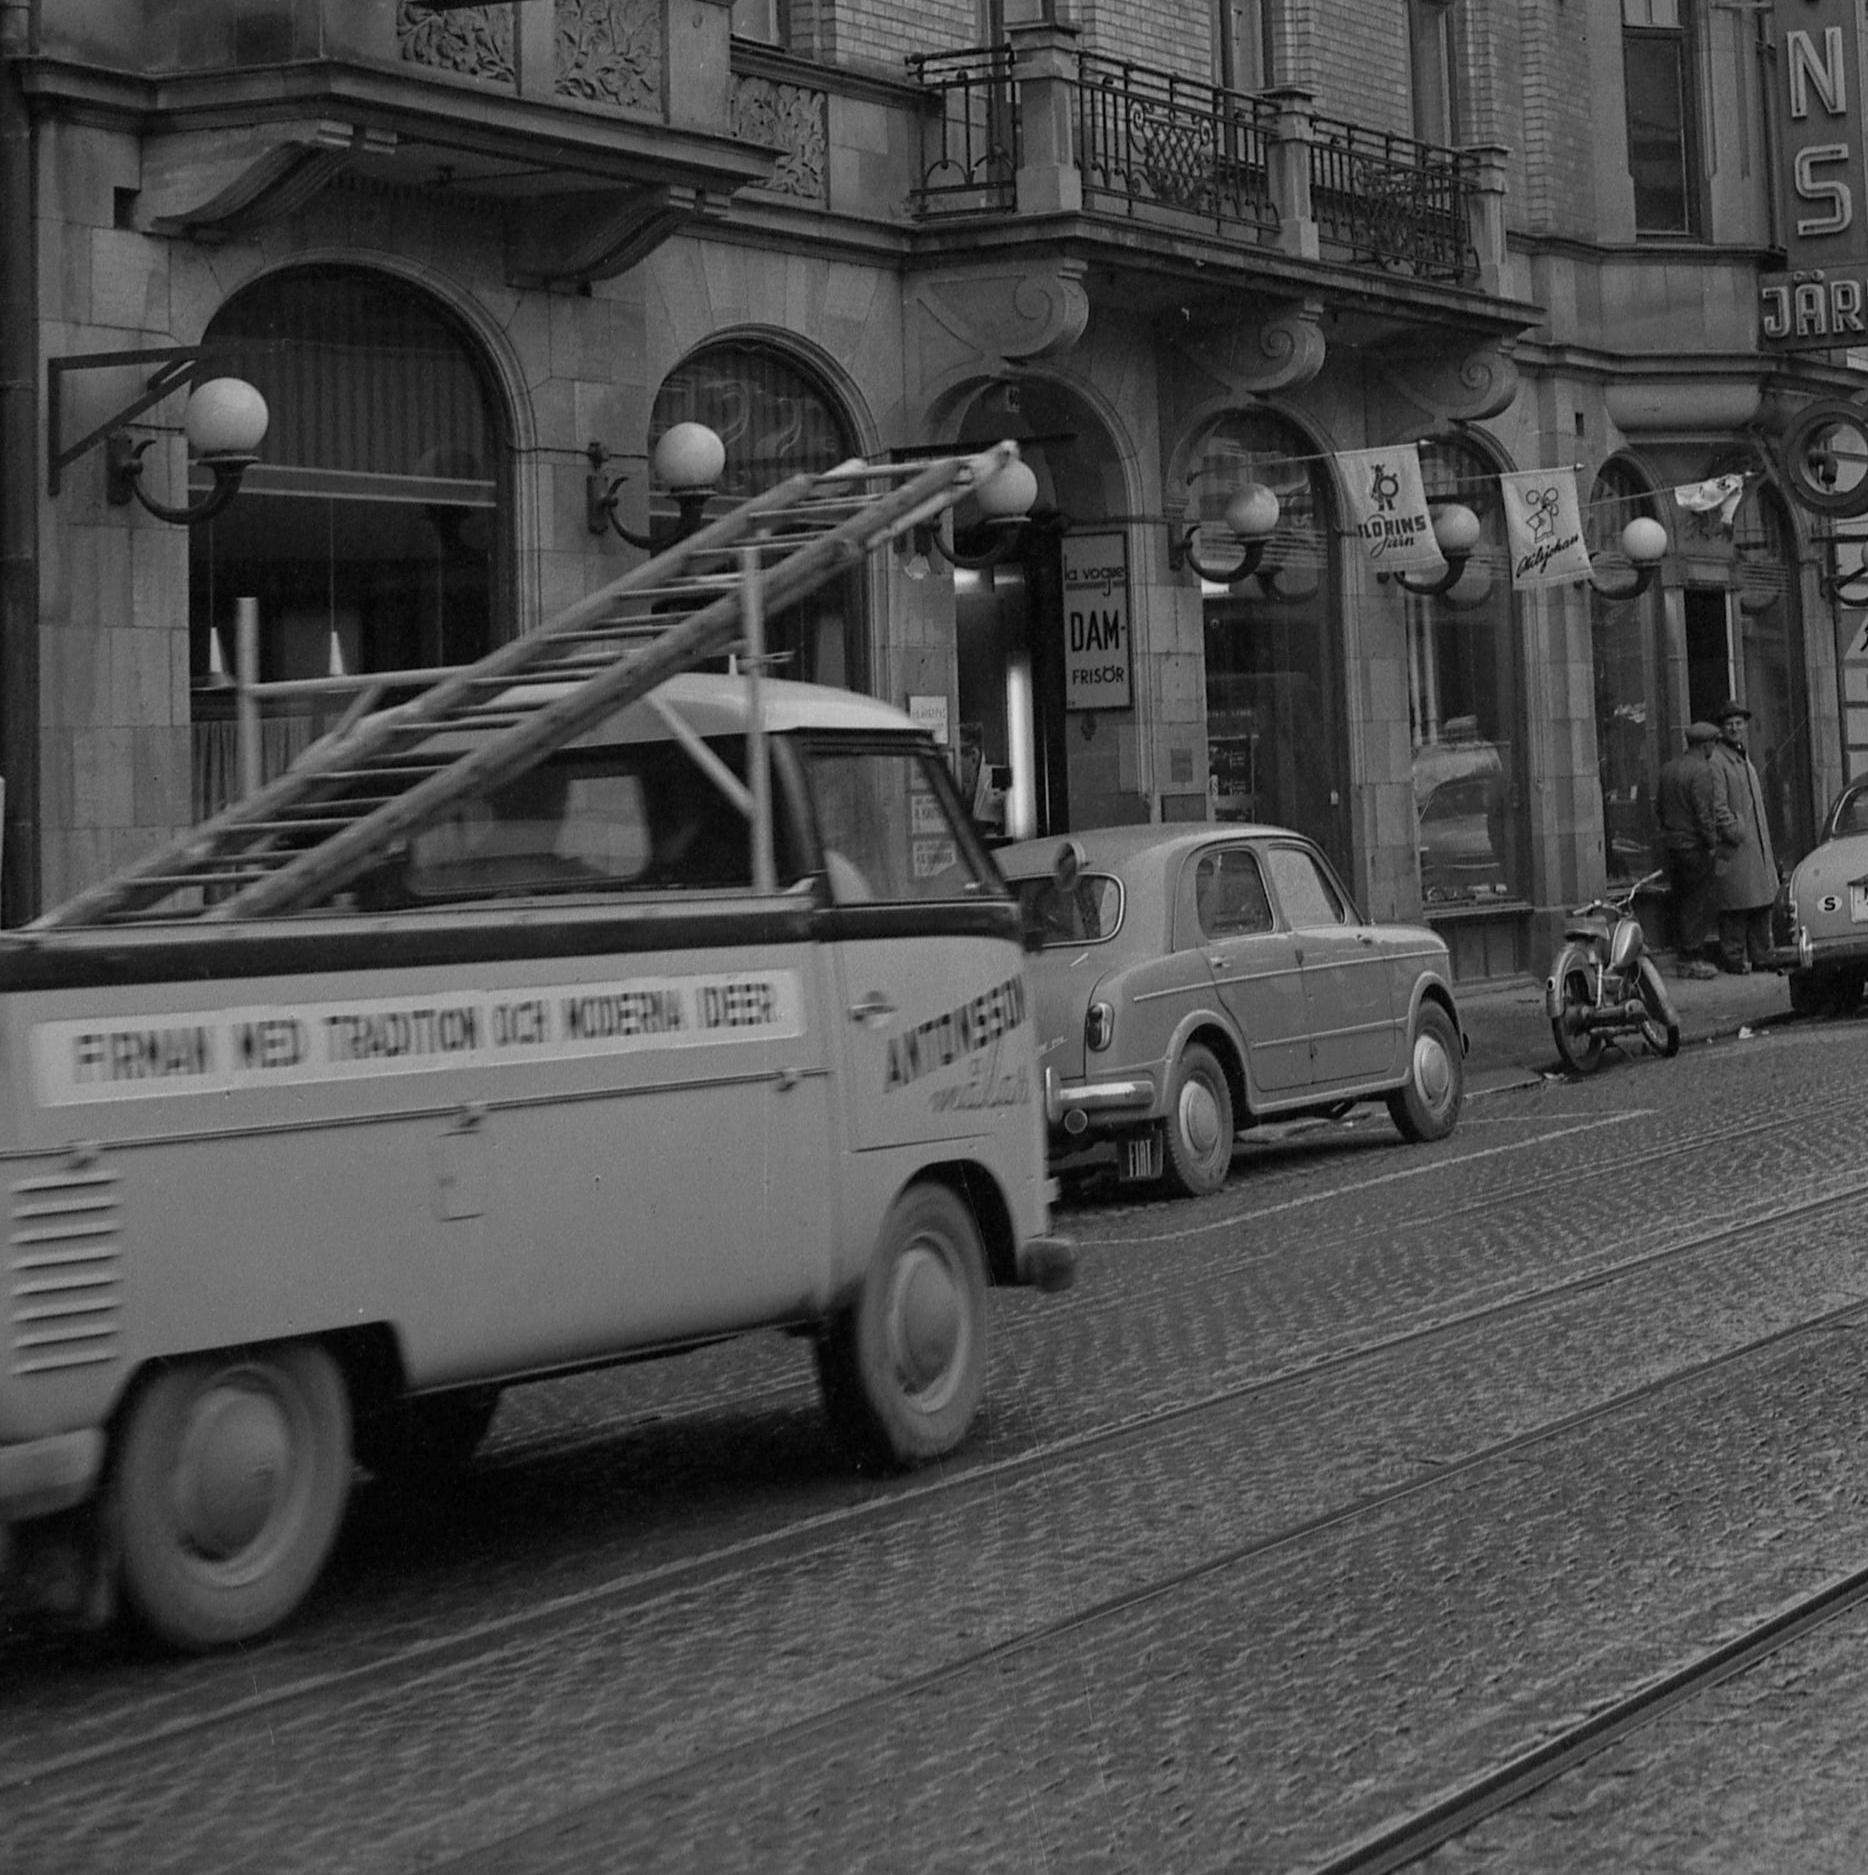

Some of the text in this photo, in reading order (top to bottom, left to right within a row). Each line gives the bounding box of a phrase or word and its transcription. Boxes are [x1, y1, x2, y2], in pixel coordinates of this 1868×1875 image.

[1063, 554, 1125, 598] la vogue
[1070, 609, 1126, 652] DAM-
[1072, 664, 1125, 686] FRISÖR
[1823, 896, 1837, 912] S
[73, 980, 780, 1085] FIRMAN MED TRADITION OCH MODERNA IDEER
[1128, 1139, 1152, 1178] FIAT
